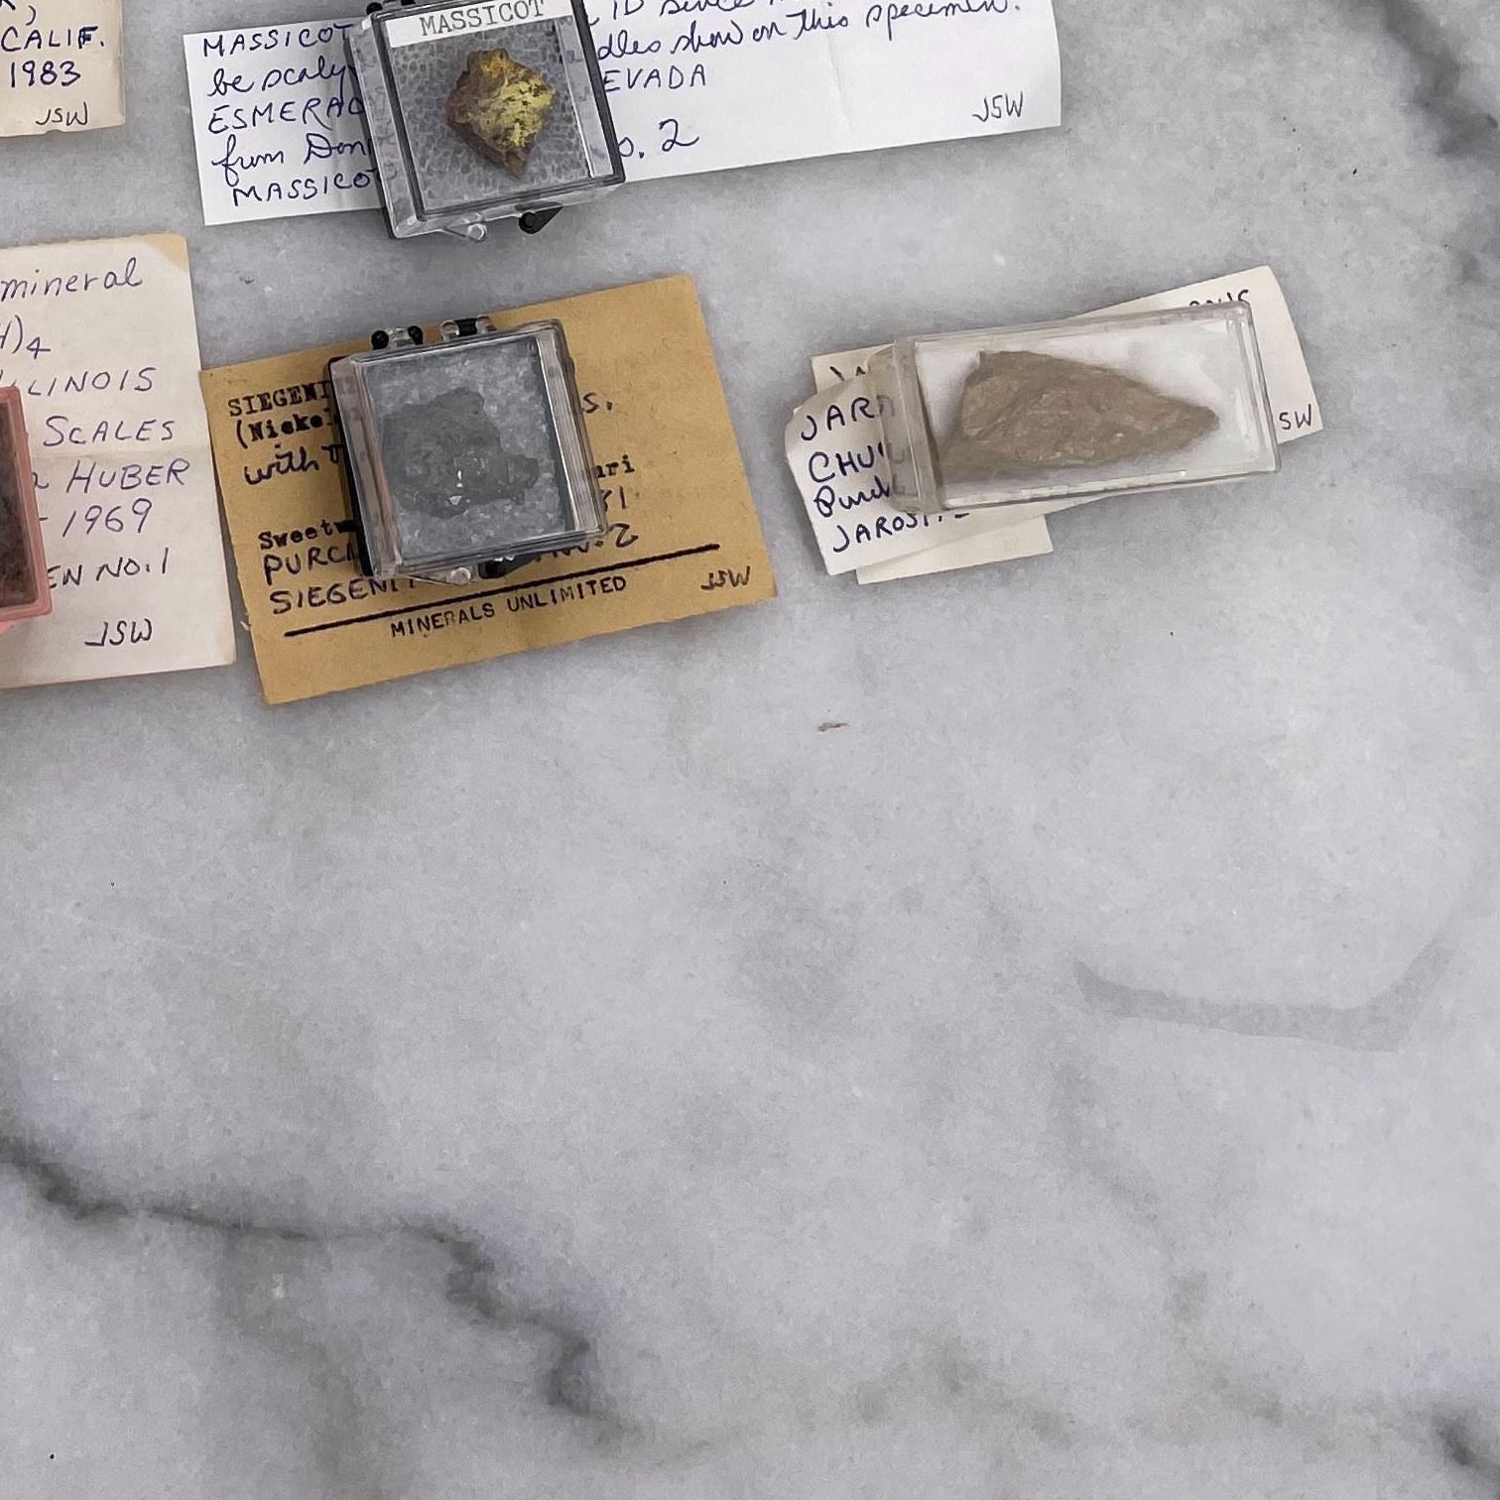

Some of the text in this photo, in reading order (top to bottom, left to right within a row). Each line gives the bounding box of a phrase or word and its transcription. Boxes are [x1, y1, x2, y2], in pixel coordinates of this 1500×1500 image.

[0, 26, 106, 52] CALIF.
[202, 23, 353, 58] MASSICOT
[10, 60, 82, 89] 1983
[207, 67, 255, 97] be
[670, 19, 744, 55] show
[604, 63, 707, 93] EVADA
[35, 101, 89, 127] JSW
[971, 90, 1025, 123] JSW
[658, 118, 700, 153] 2
[211, 133, 285, 188] from
[0, 256, 144, 303] mineral
[227, 380, 331, 418] SIEGENI
[42, 414, 176, 448] SCALES
[801, 396, 876, 441] JAR
[65, 457, 191, 494] HUBER
[243, 442, 320, 486] with
[61, 497, 154, 538] 1969
[609, 522, 639, 548] 2
[95, 546, 170, 583] NO. 1
[390, 575, 627, 637] MINERALS UNLIMITED
[84, 618, 153, 647] JSW
